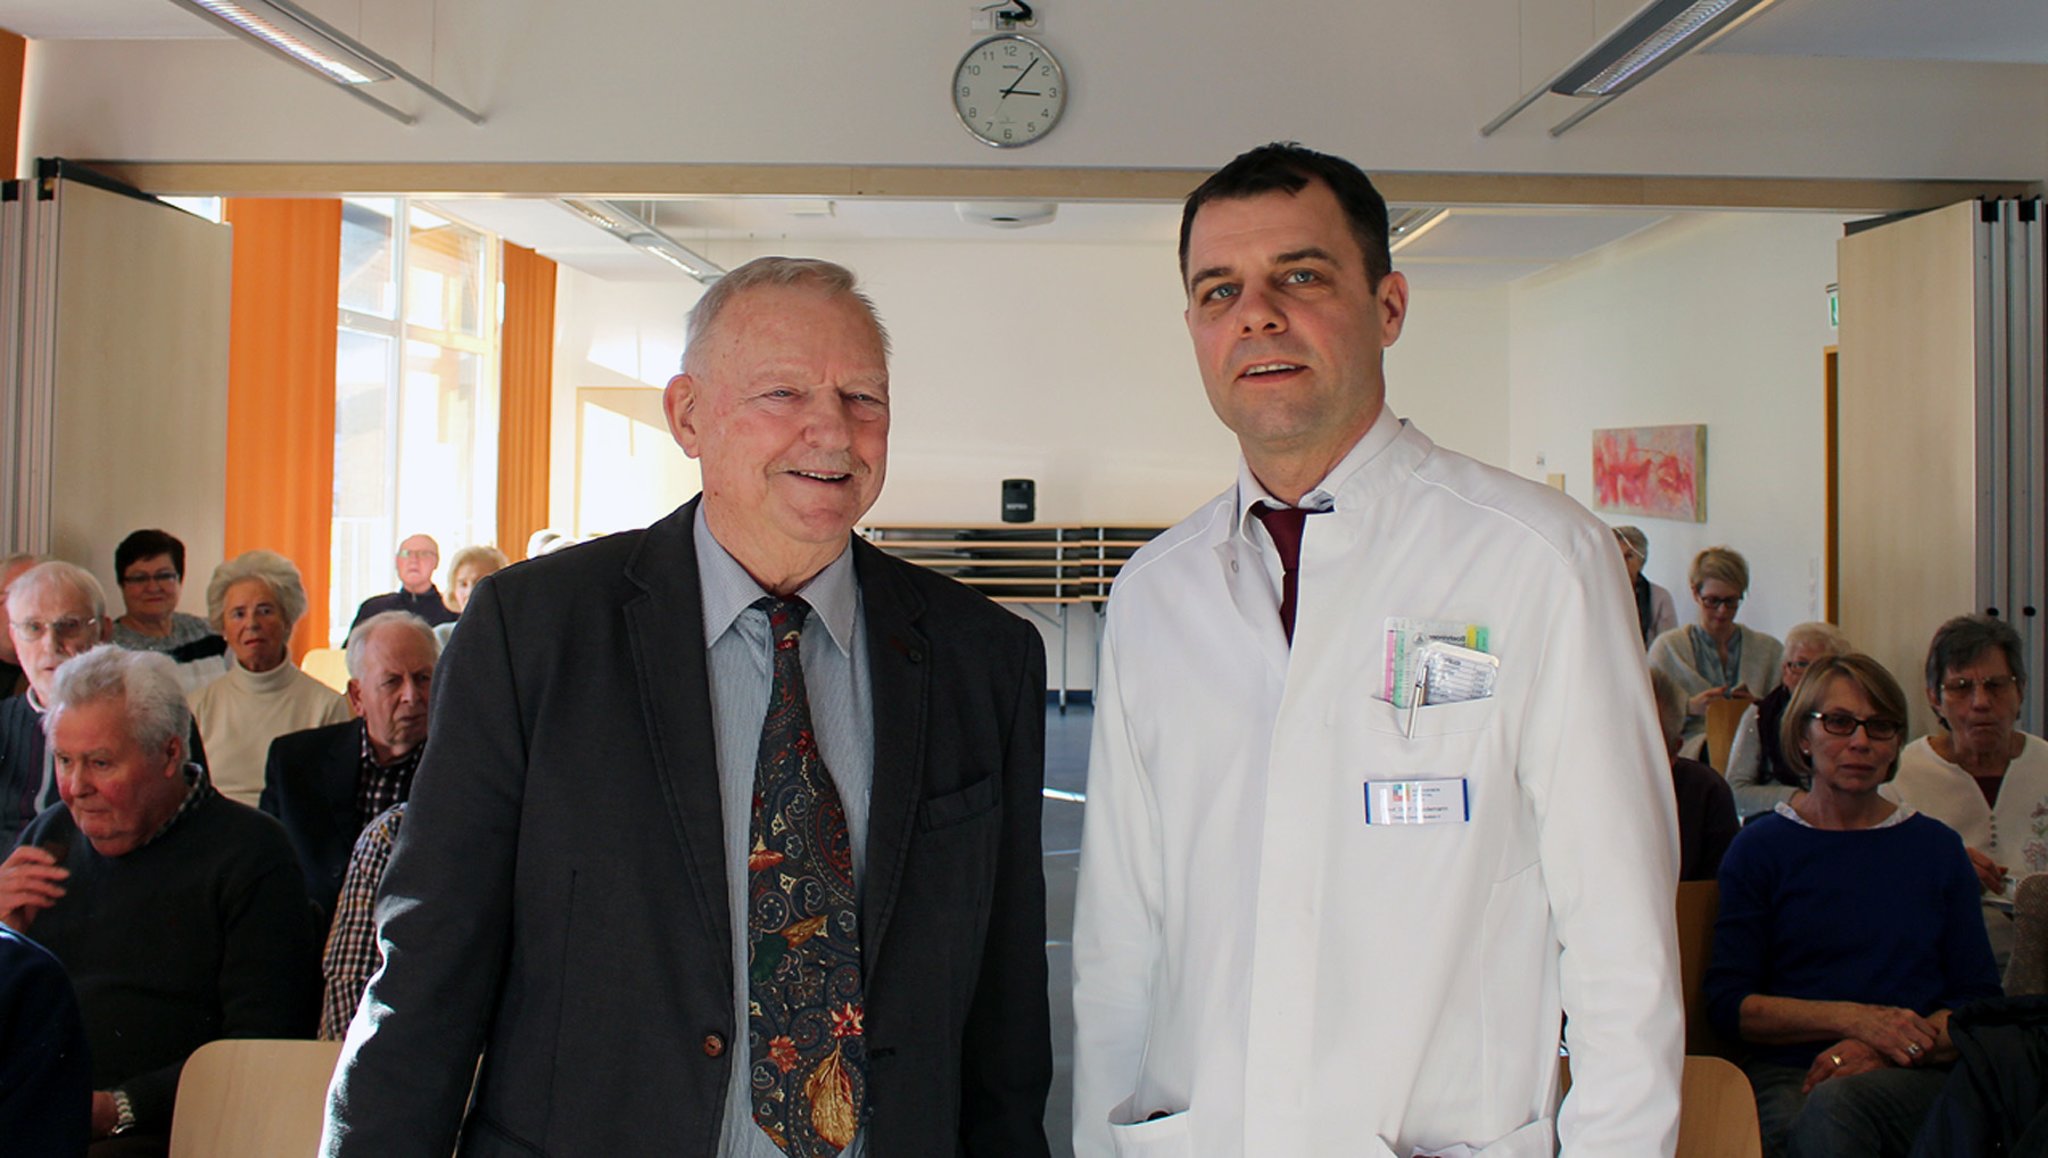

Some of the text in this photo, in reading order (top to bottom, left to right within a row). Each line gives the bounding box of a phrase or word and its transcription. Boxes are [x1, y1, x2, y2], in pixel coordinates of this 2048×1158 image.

[982, 51, 994, 60] 11
[1004, 46, 1017, 57] 12
[1029, 52, 1034, 60] 1
[967, 65, 980, 76] 10
[1041, 65, 1050, 76] 2
[962, 86, 970, 97] 9
[1049, 87, 1057, 98] 3
[969, 107, 977, 118] 8
[1040, 108, 1049, 117] 4
[985, 121, 993, 131] 7
[1027, 122, 1036, 132] 5
[1003, 128, 1012, 139] 6
